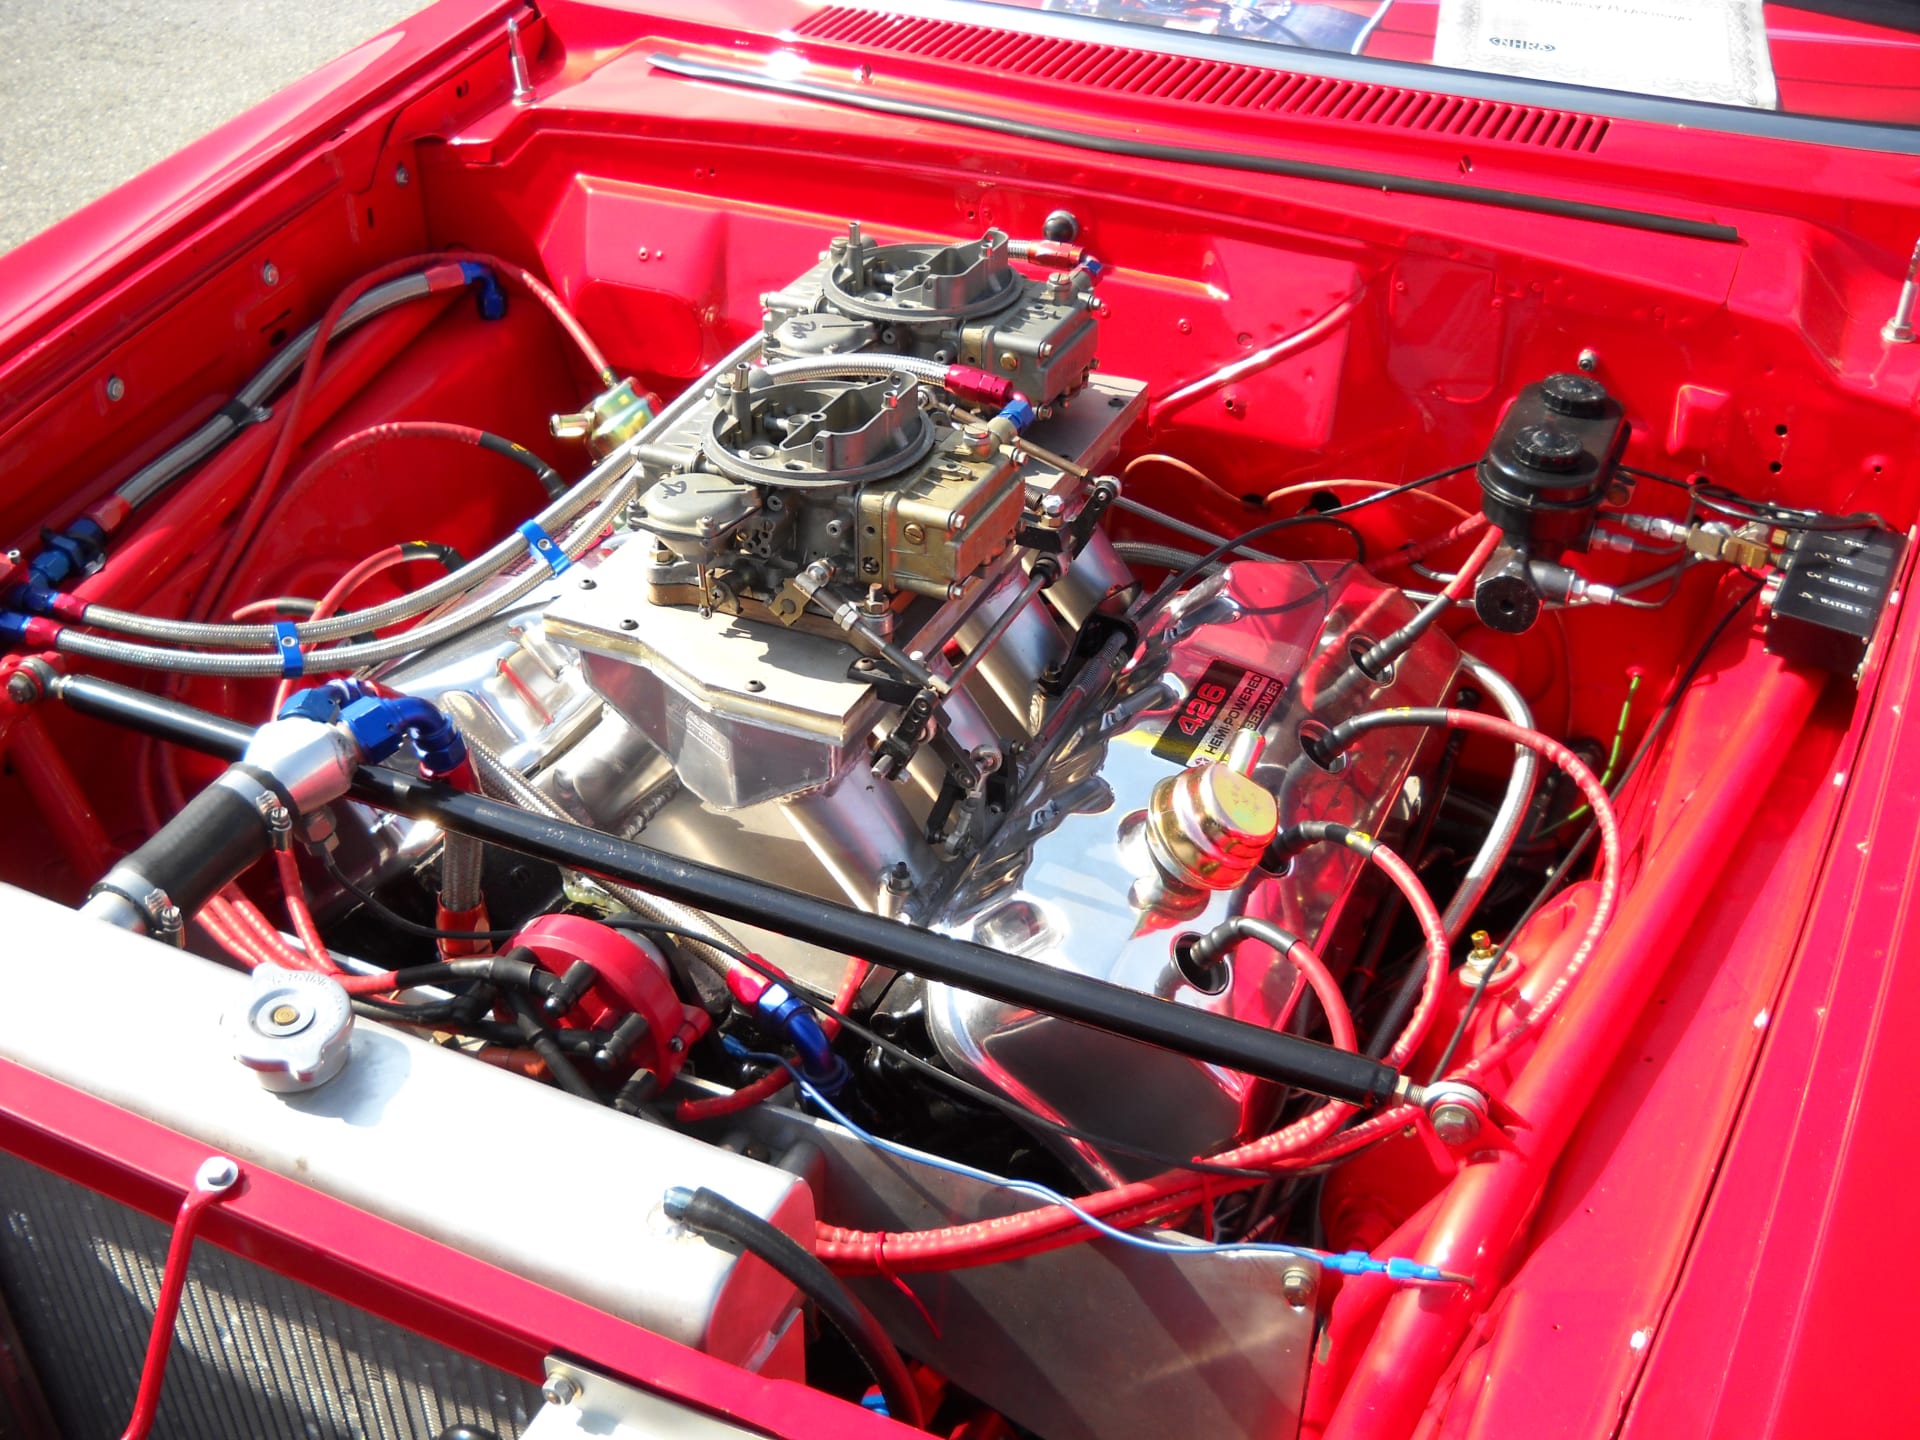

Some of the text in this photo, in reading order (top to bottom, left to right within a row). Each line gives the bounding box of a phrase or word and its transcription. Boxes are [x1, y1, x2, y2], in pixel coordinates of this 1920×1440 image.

[1497, 37, 1548, 51] NHRA
[1814, 551, 1853, 566] 2 OIL
[1806, 571, 1870, 592] 3 BLOW BY
[1798, 591, 1814, 599] 4
[1819, 597, 1853, 611] WATER
[1177, 682, 1227, 736] 426
[1244, 681, 1282, 731] SEPOWER
